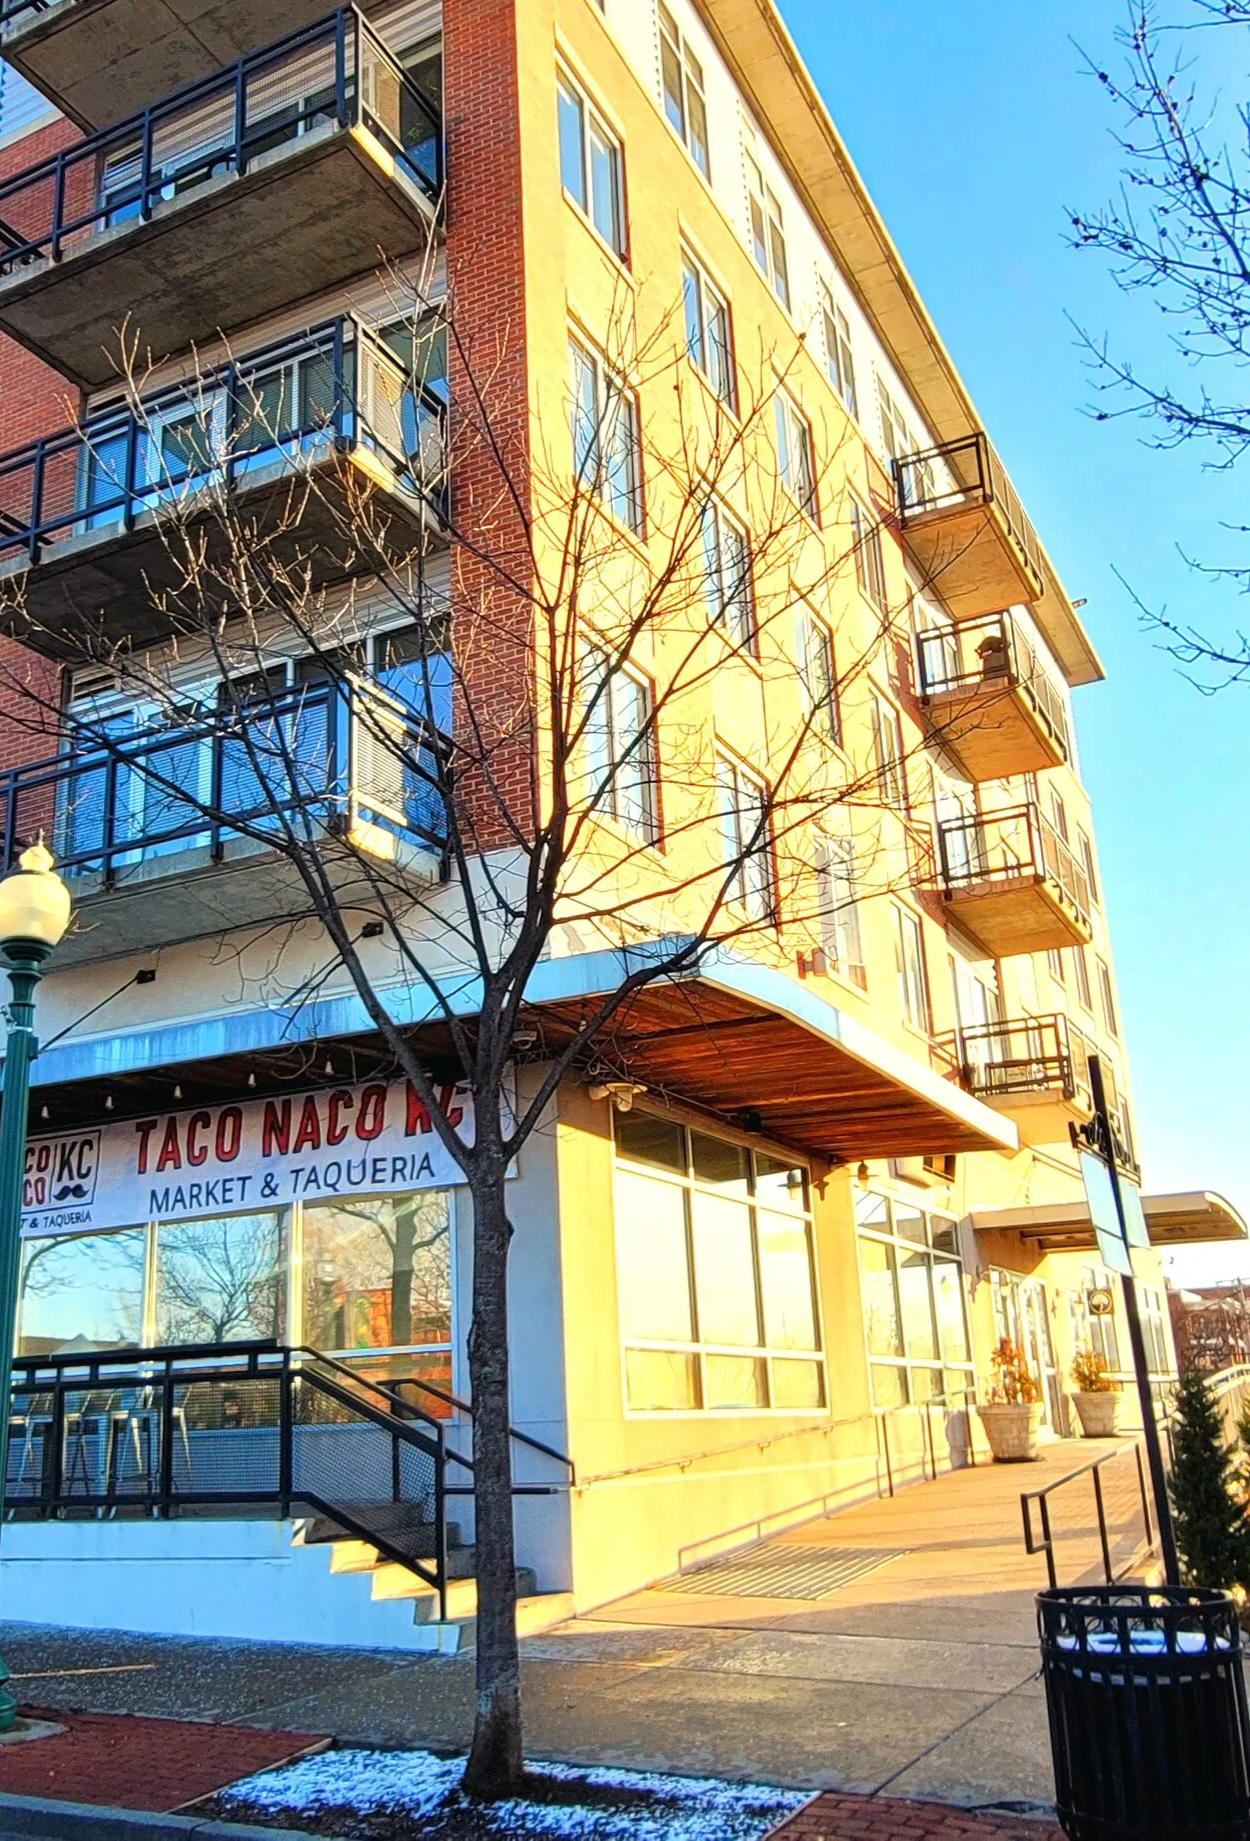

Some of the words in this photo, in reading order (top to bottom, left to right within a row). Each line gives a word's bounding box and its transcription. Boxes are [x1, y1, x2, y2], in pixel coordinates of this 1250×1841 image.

[135, 1106, 244, 1175] TACO
[262, 1084, 388, 1157] NACO
[24, 1145, 51, 1174] CO
[57, 1139, 94, 1182] KC
[23, 1177, 46, 1207] CO
[149, 1175, 252, 1214] MARKET
[260, 1172, 279, 1198] &
[290, 1151, 435, 1194] TAQUERIA
[43, 1210, 92, 1229] TAQUERIA
